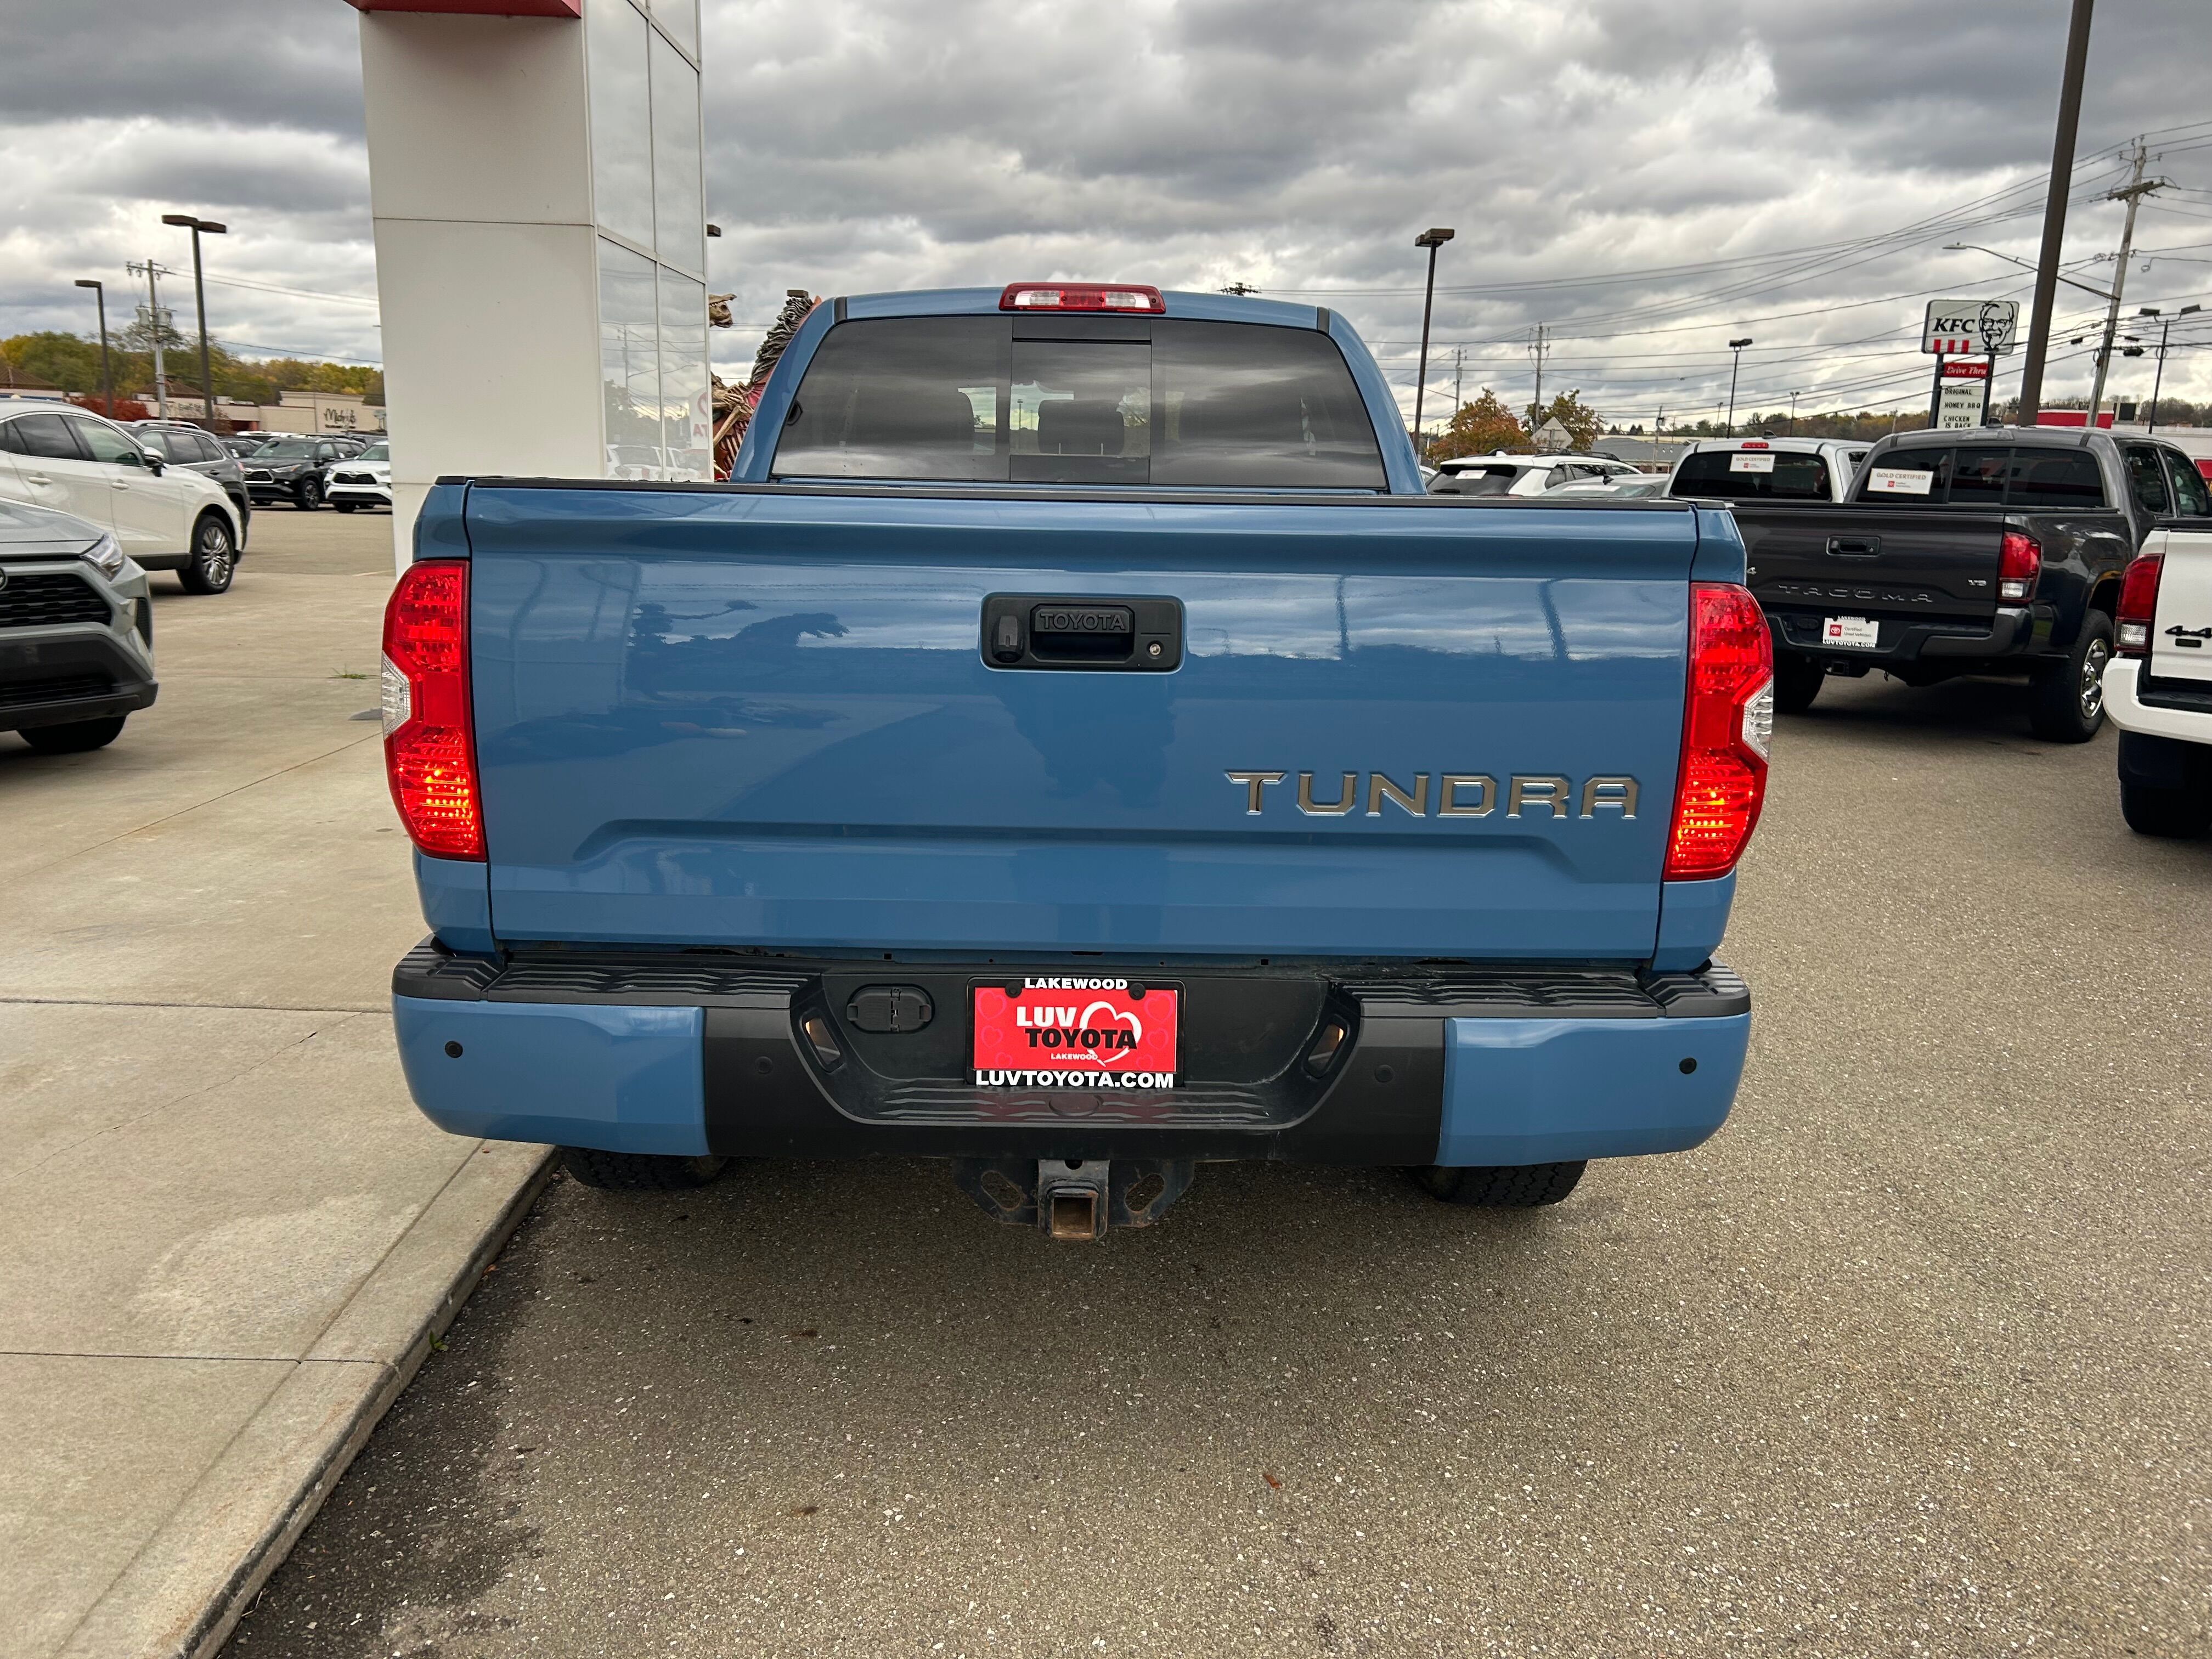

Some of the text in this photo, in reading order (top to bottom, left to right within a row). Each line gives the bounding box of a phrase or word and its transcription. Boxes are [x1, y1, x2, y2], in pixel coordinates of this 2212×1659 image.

[1932, 318, 1974, 333] KFC
[1946, 366, 1987, 375] Drive Thru
[1778, 584, 1933, 602] TACOMA
[1040, 613, 1126, 630] TOYOTA
[1822, 639, 1876, 648] LUVTOYOTA.COM
[1224, 771, 1640, 820] TUNDRA
[1025, 977, 1128, 990] LAKEWOOD
[1016, 1006, 1077, 1028] LUV
[1025, 1028, 1137, 1050] TOYOTA
[975, 1070, 1174, 1088] LUVTOYOTA.COM
